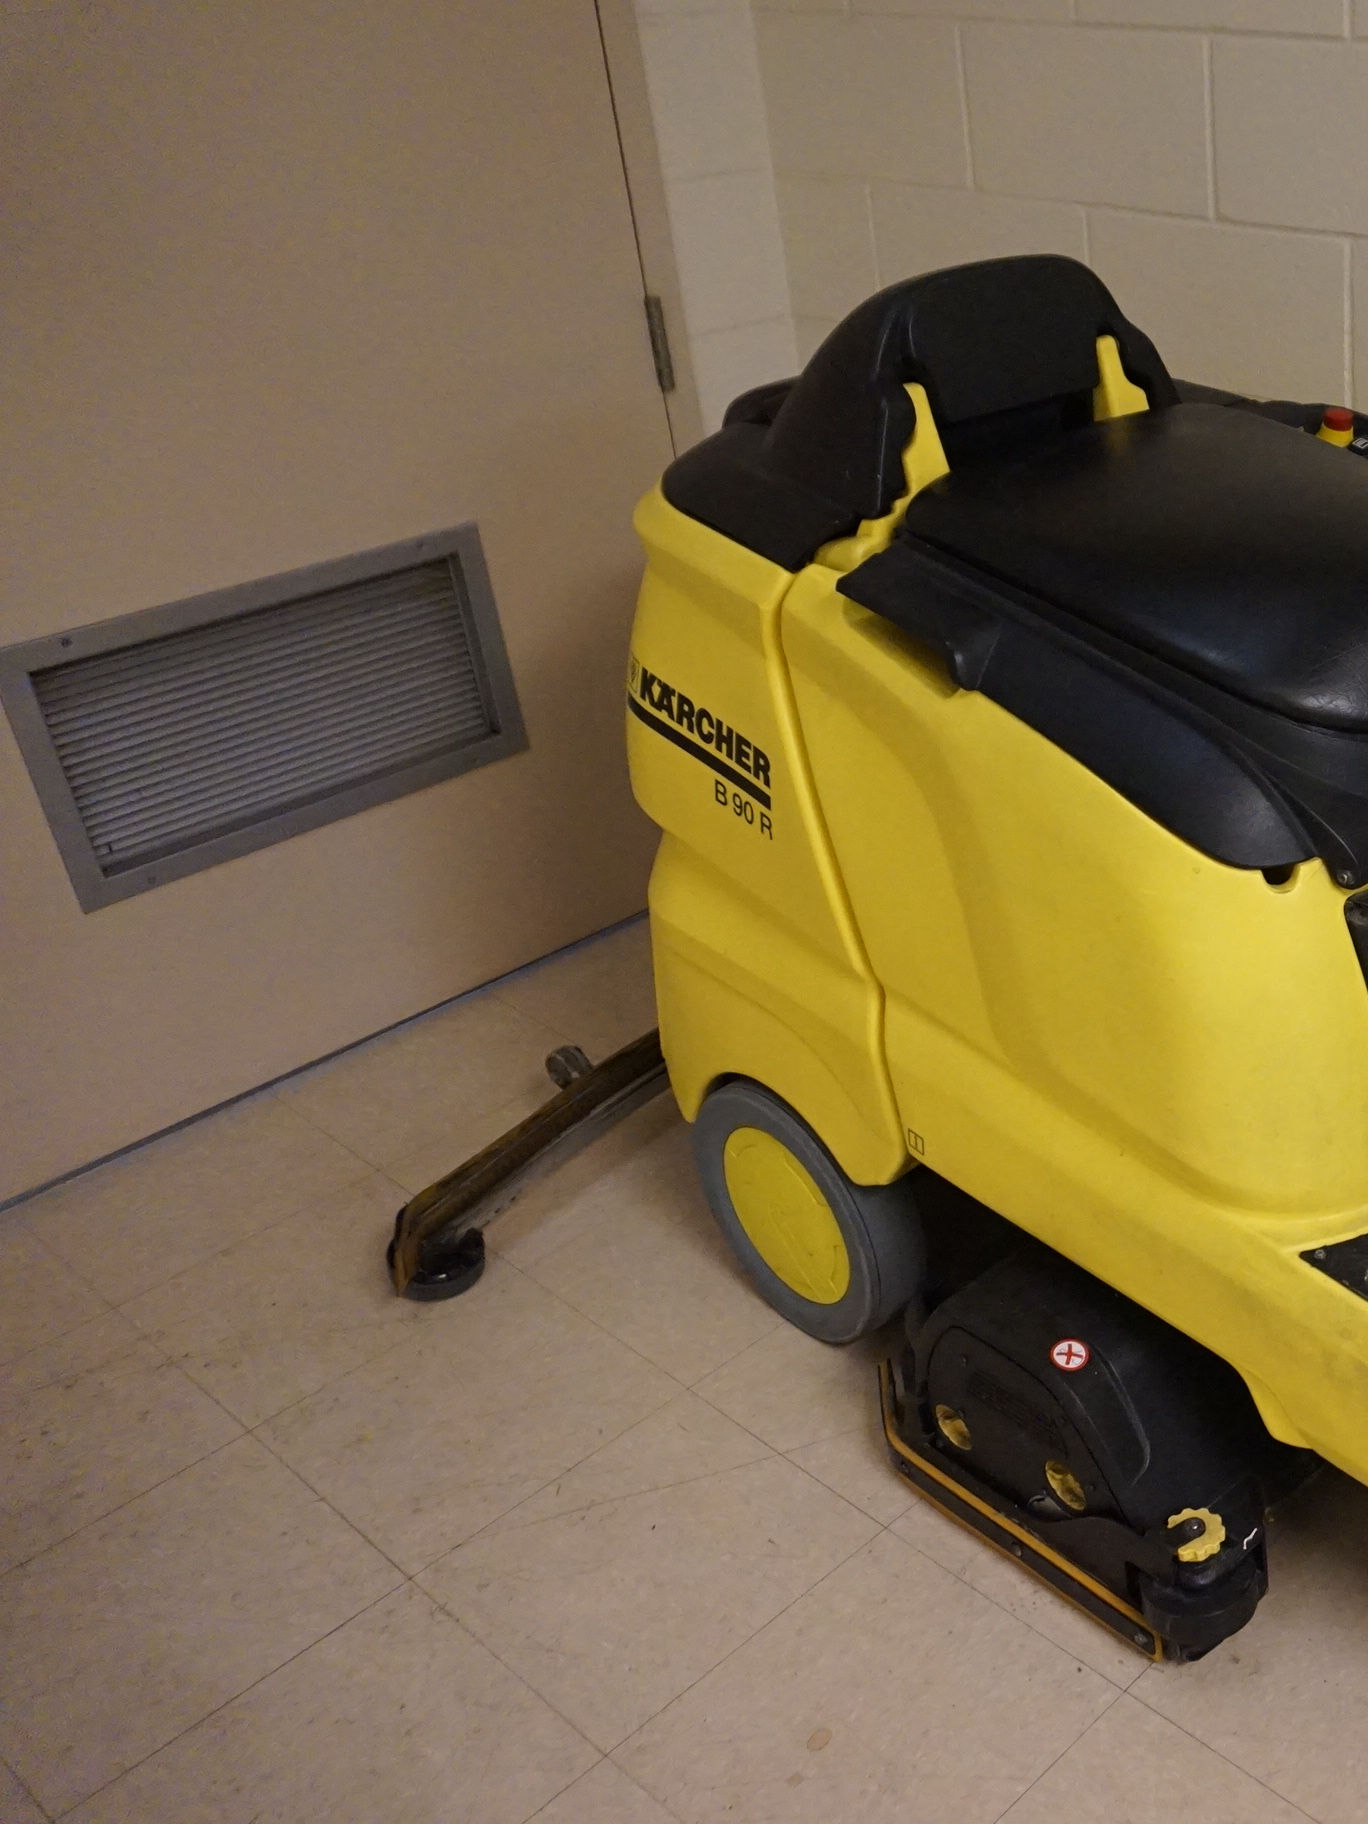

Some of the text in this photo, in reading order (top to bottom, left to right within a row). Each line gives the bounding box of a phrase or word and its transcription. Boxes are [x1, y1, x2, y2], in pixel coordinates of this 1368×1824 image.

[639, 665, 771, 790] KÄRCHER
[714, 778, 773, 841] B 90 R
